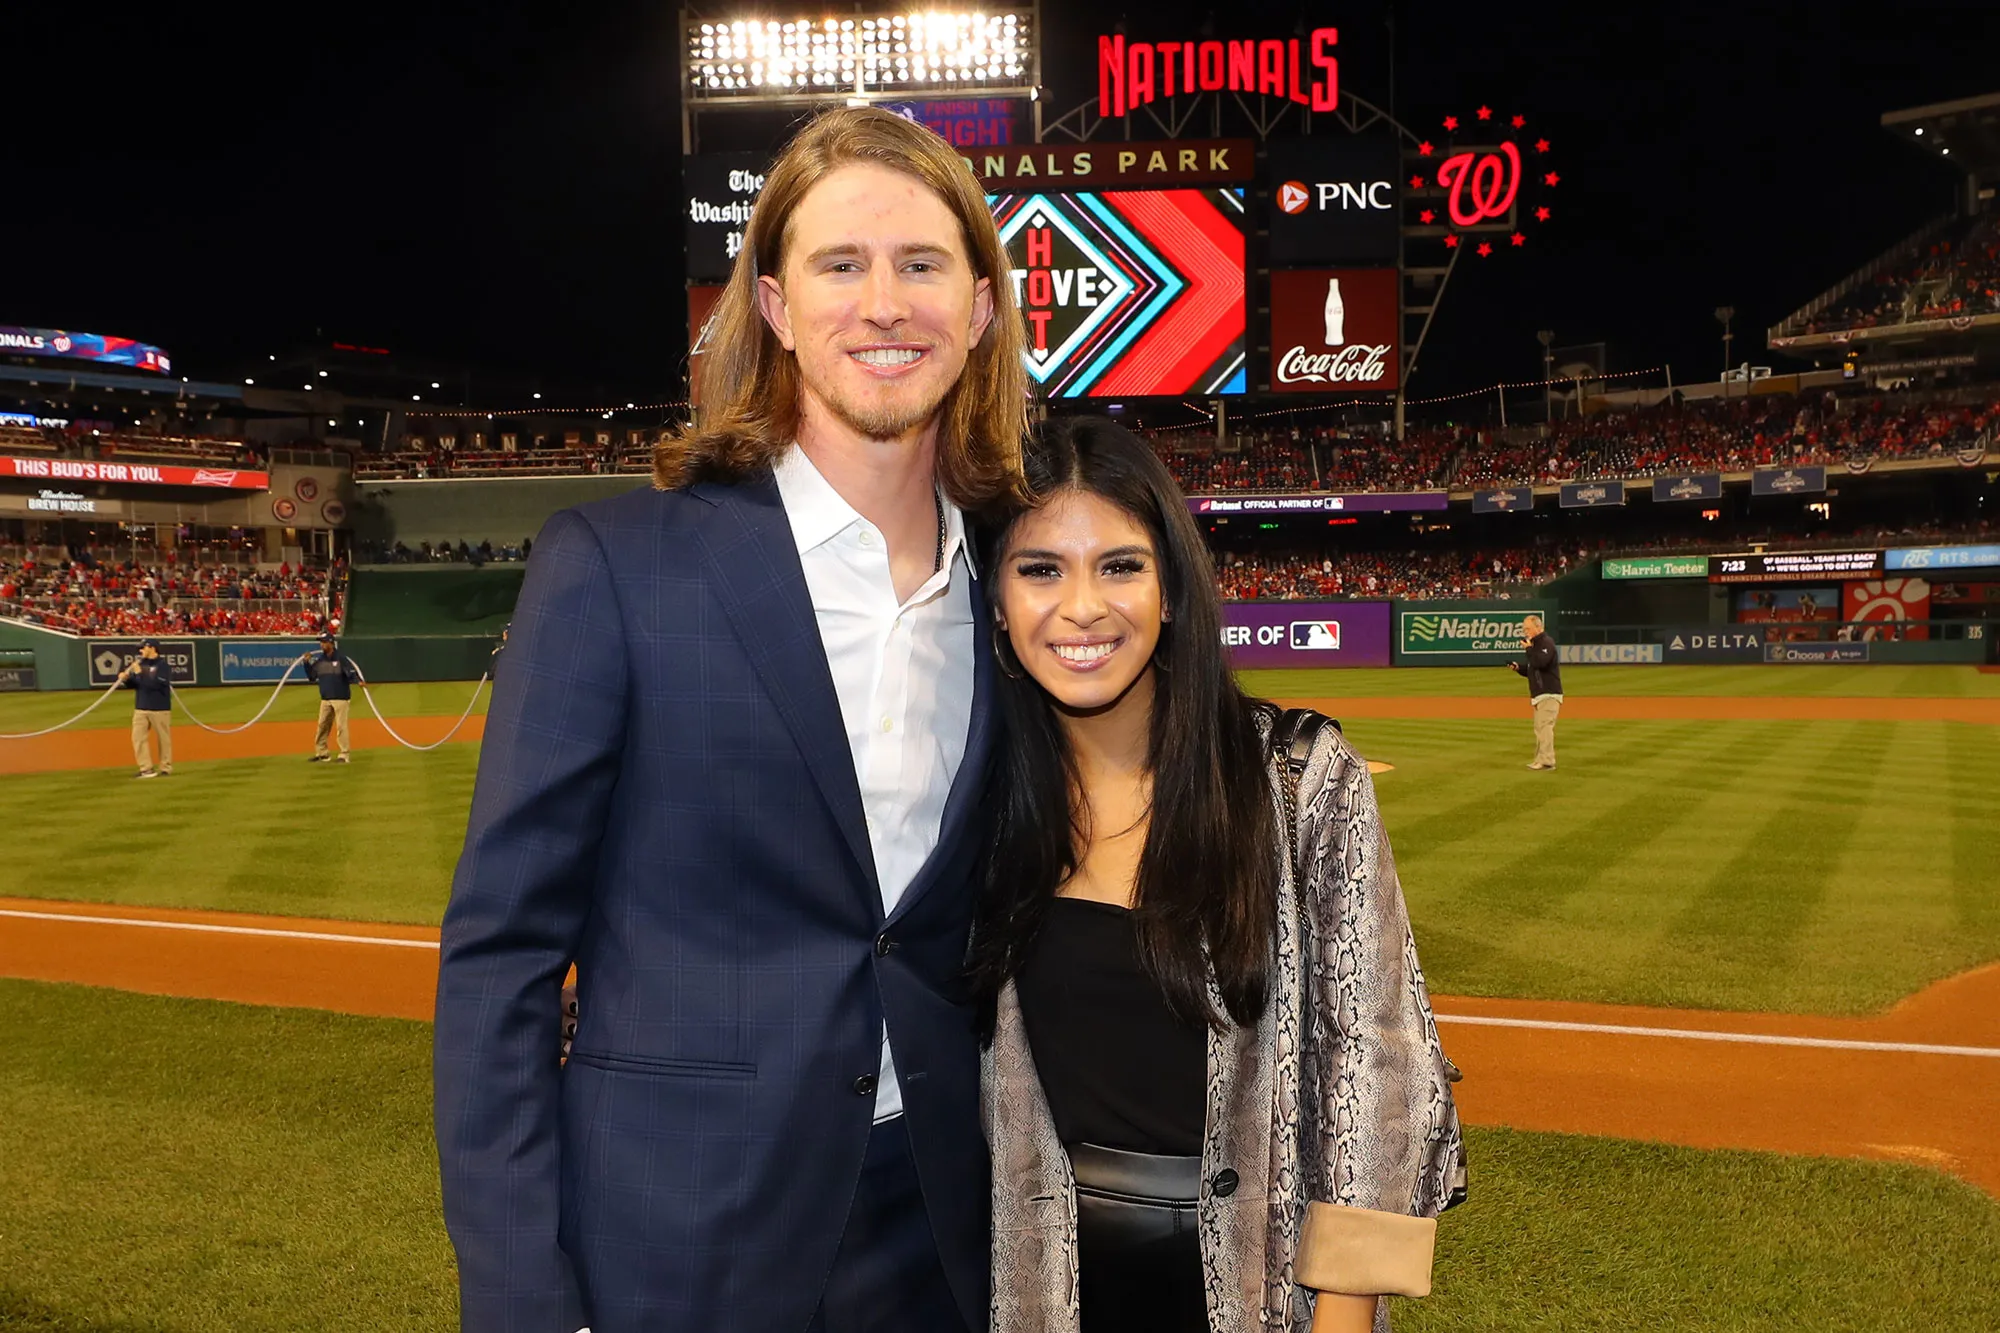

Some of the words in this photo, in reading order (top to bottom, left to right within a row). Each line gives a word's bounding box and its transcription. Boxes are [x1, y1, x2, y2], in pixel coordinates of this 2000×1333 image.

[1099, 28, 1338, 117] NATIONALS
[925, 101, 979, 115] FINISH
[1118, 149, 1230, 173] PARK
[728, 169, 765, 194] The
[1437, 141, 1521, 226] W
[1315, 181, 1392, 210] PNC
[689, 197, 754, 225] Washi
[1009, 268, 1098, 307] TOVE
[0, 333, 45, 349] NALS
[1277, 344, 1391, 383] Coca-Cola
[13, 459, 49, 476] THIS
[51, 460, 97, 478] BUD'S
[99, 464, 127, 480] FOR
[130, 466, 163, 482] YOU.
[28, 498, 60, 511] BREW
[60, 500, 96, 512] HOUSE
[1244, 501, 1278, 509] OFFICIAL
[1279, 499, 1311, 509] PARTNER
[1312, 499, 1324, 508] OF
[1622, 564, 1661, 576] Harris
[1664, 562, 1705, 575] Teeter
[1722, 560, 1746, 572] 7:23
[1800, 563, 1824, 572] GOING
[1824, 562, 1835, 570] TO
[1835, 562, 1850, 570] GET
[1851, 561, 1874, 569] RIGHT
[1257, 626, 1285, 645] OF
[1438, 618, 1524, 639] Nationa
[1472, 640, 1490, 649] Car
[1494, 640, 1522, 649] Rent
[1692, 635, 1758, 648] DELTA
[1583, 644, 1653, 662] KOCH
[1787, 650, 1825, 660] Choose
